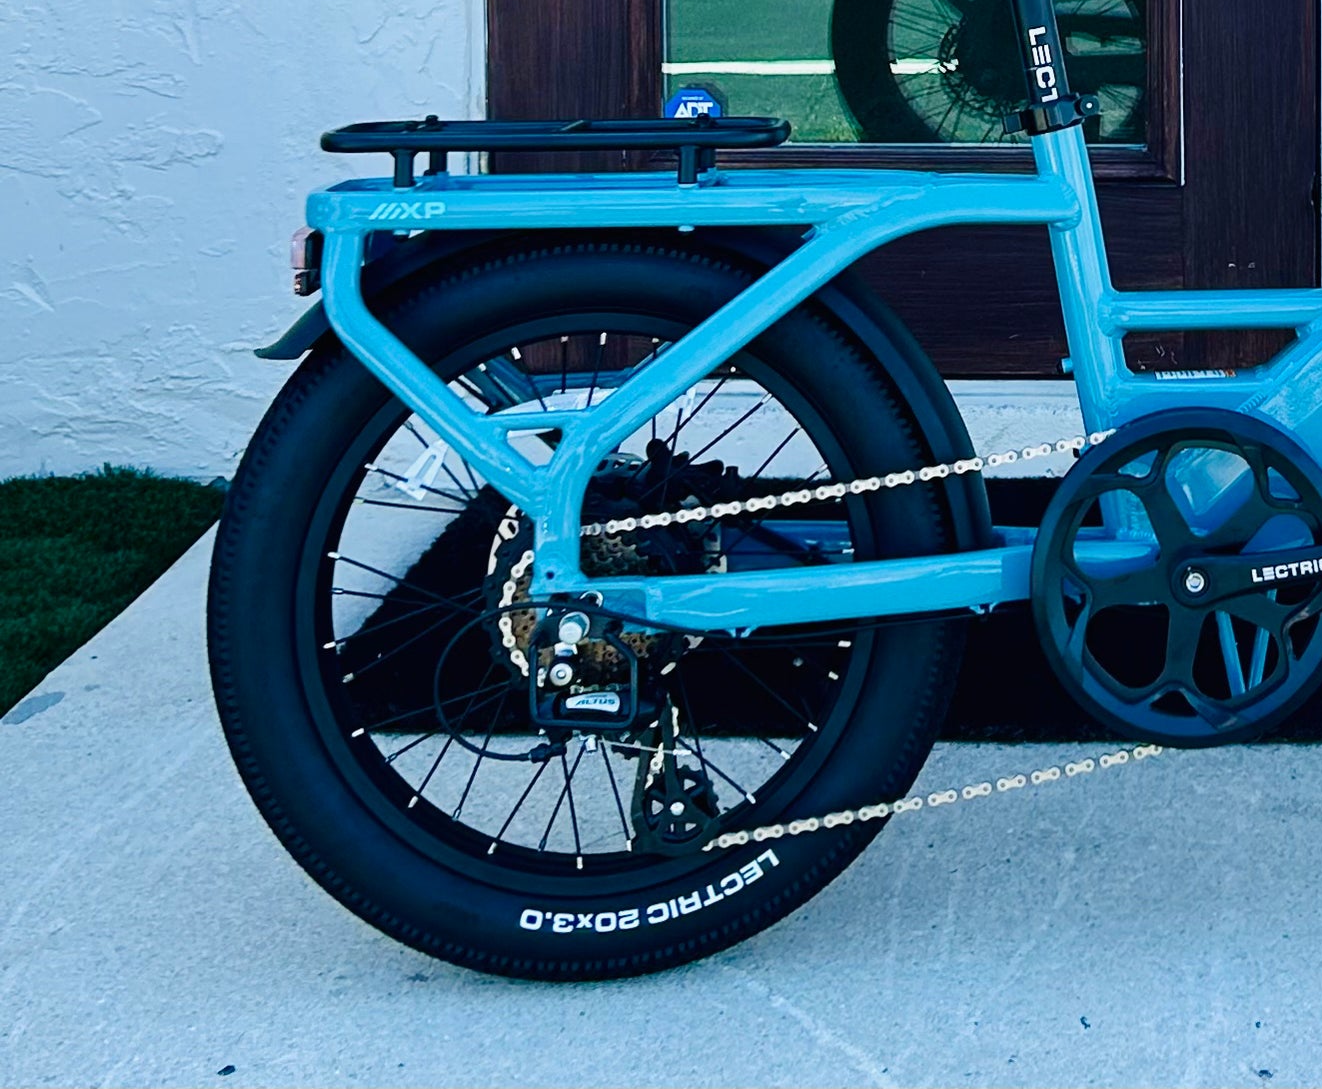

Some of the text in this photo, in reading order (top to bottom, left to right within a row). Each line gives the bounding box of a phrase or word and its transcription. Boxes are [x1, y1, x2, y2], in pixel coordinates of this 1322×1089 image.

[673, 101, 714, 119] ADT
[575, 698, 616, 707] ALTUS
[518, 847, 781, 934] LECTRIC 20x3.0
